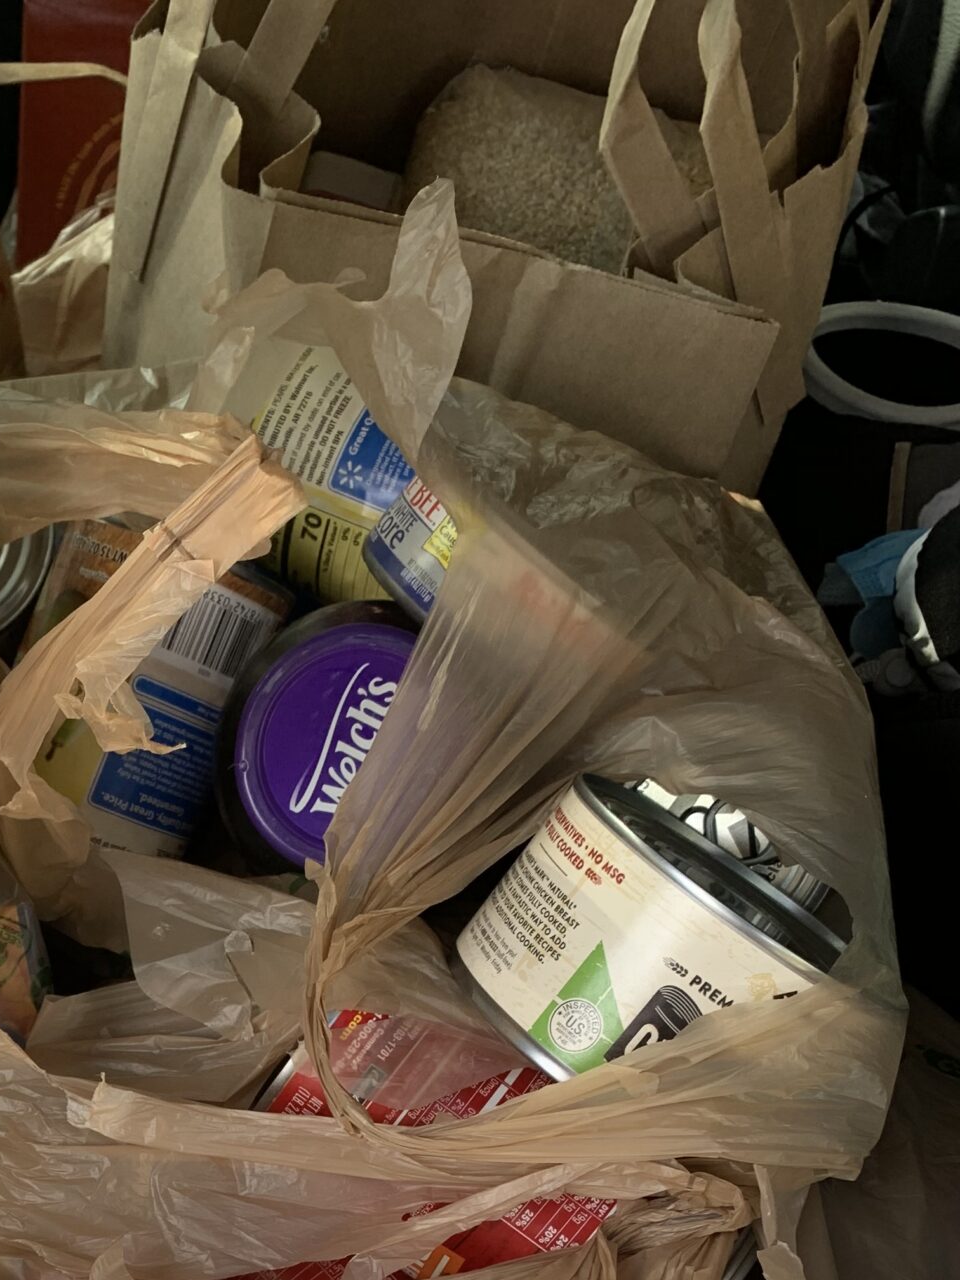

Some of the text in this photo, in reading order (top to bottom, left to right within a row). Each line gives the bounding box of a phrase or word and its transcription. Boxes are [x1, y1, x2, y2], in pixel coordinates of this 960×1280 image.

[348, 426, 369, 456] Great
[300, 512, 323, 543] 70
[309, 675, 398, 815] Welch's
[556, 839, 584, 870] COOKED
[588, 848, 626, 885] NO MSG
[526, 890, 568, 939] FULLY COOKED,
[532, 880, 580, 931] CHICKEN BREAST
[510, 908, 534, 937] FAVORITE
[533, 933, 563, 962] RECIPES
[516, 931, 546, 965] COOKING.
[529, 911, 543, 929] WAY
[540, 924, 552, 937] TO
[549, 934, 567, 951] ADD
[689, 975, 735, 1009] PREM
[562, 1002, 600, 1035] INSPECTED
[565, 1015, 586, 1038] U.S.
